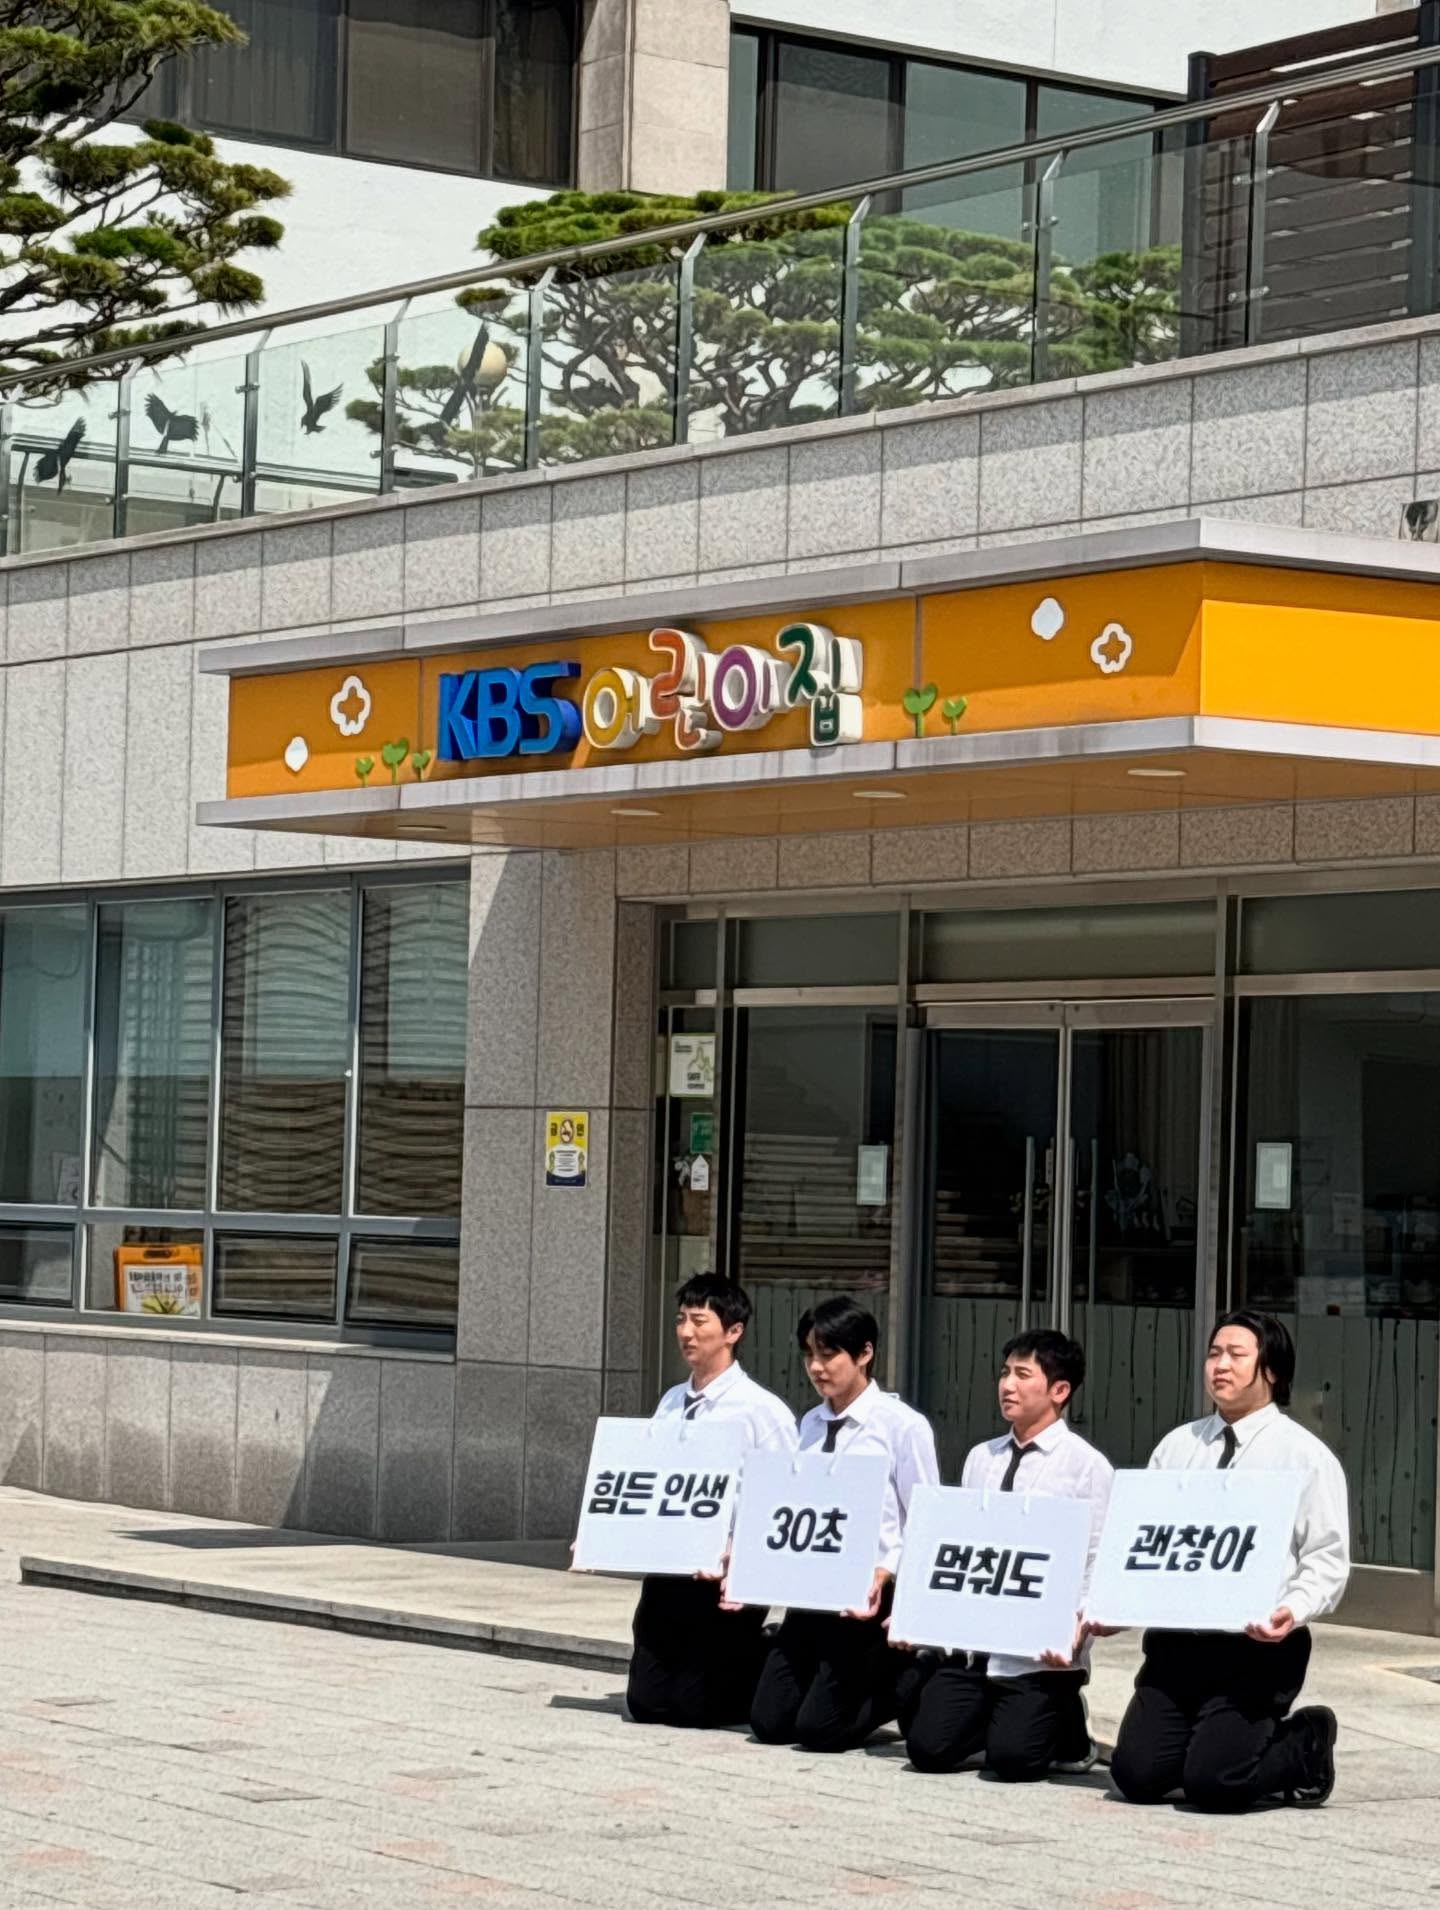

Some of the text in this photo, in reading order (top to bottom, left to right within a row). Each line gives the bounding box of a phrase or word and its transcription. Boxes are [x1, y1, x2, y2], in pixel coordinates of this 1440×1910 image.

[437, 623, 864, 760] KBS 어린이집
[587, 1470, 730, 1518] 힘든 인생
[766, 1505, 848, 1554] 30초
[1123, 1524, 1258, 1573] 괜찮아
[928, 1543, 1051, 1599] 멈취도
